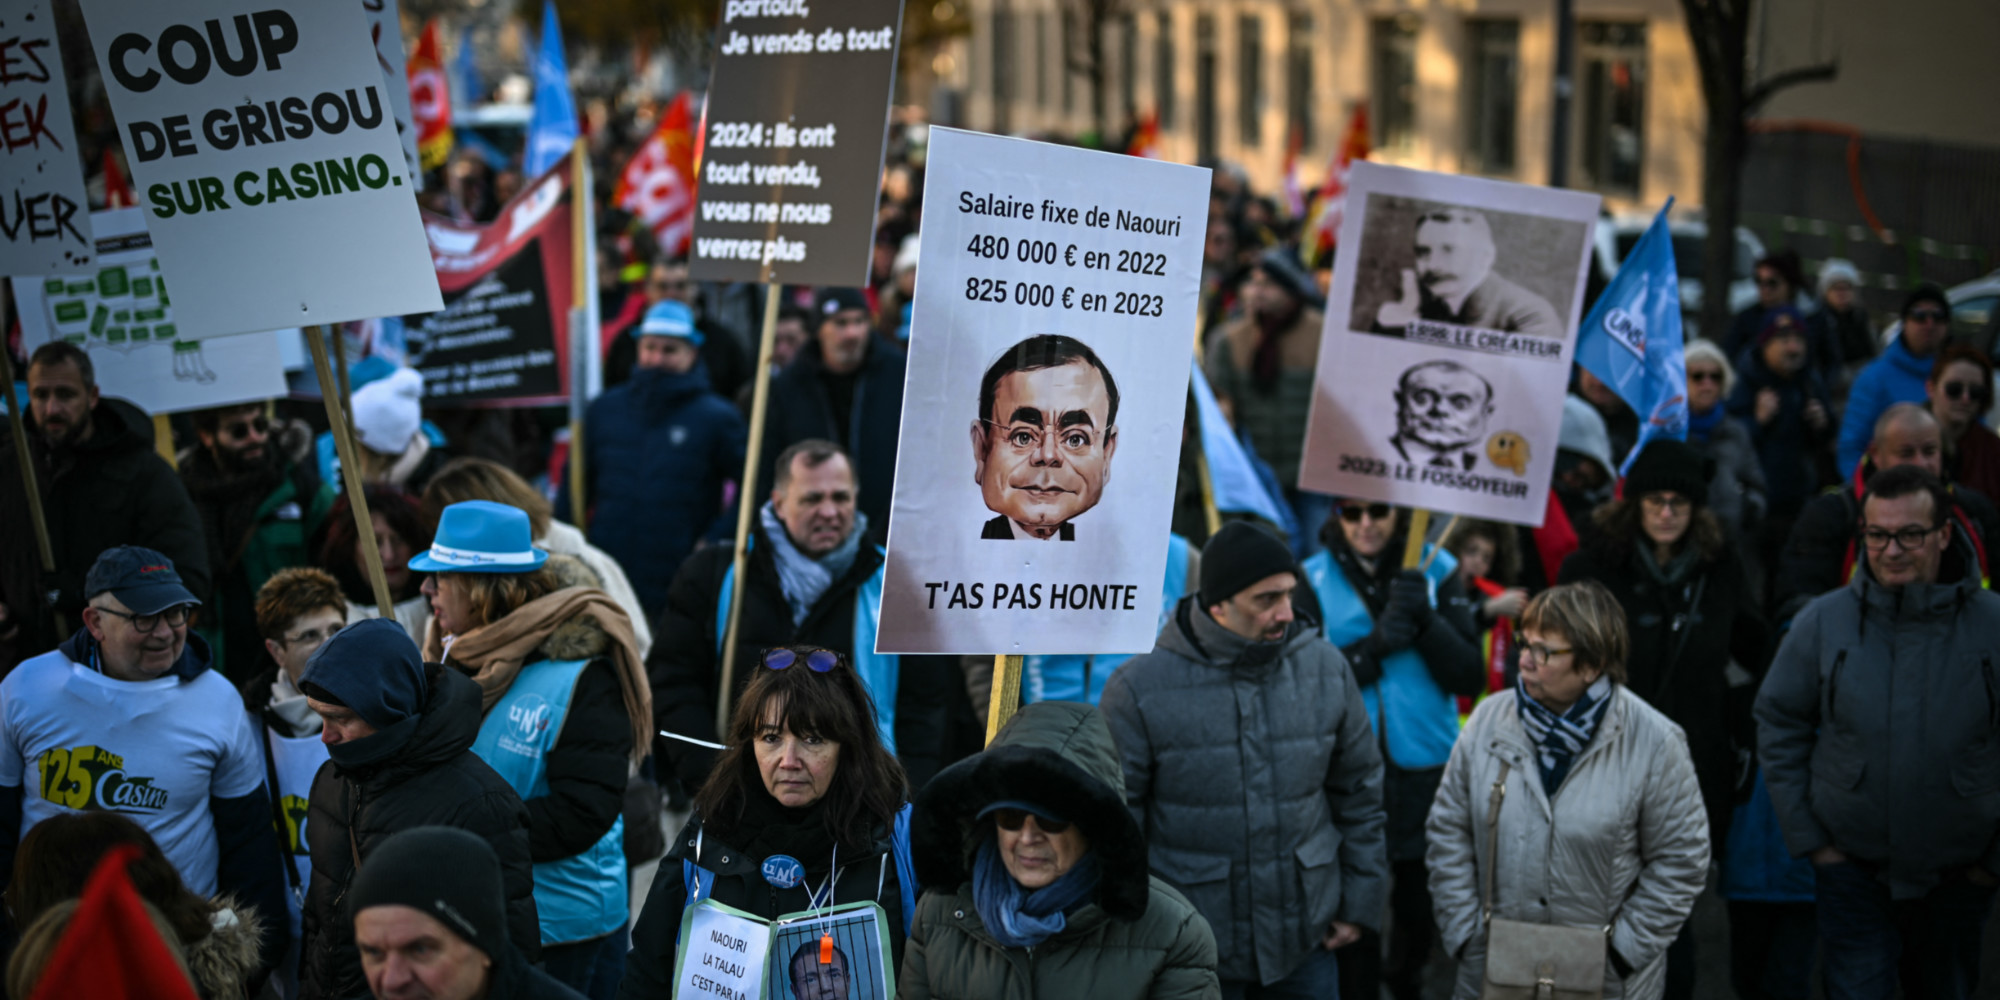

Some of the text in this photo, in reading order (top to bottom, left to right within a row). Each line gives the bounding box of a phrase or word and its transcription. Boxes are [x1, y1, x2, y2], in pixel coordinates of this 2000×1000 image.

[108, 9, 299, 93] COUP
[721, 25, 893, 55] Je vends de tout
[128, 114, 198, 162] DE
[202, 86, 383, 151] GRISOU
[710, 122, 764, 148] 2024
[773, 122, 797, 147] Ils
[799, 123, 836, 148] ont
[148, 176, 232, 219] SUR
[233, 153, 402, 206] CASINO.
[706, 160, 821, 189] tout vendu,
[702, 200, 832, 225] vous ne nous
[958, 191, 1181, 237] Salaire fixe de Naouri
[697, 235, 806, 267] verrez plus
[967, 234, 1167, 277] 480 000 € en 2022
[965, 277, 1164, 318] 825 000 € en 2023
[1454, 327, 1474, 345] LE
[1478, 331, 1562, 358] CRÉATEUR
[1395, 464, 1417, 482] LE
[1421, 468, 1529, 499] FOSSOYEUR
[925, 581, 1137, 610] T'AS PAS HONTE
[38, 745, 124, 810] 125 ANS
[95, 769, 169, 810] Casino
[710, 929, 748, 954] NAOURI
[702, 952, 745, 979] LA TALAU
[691, 973, 715, 993] C'EST
[715, 983, 733, 1000] PAR
